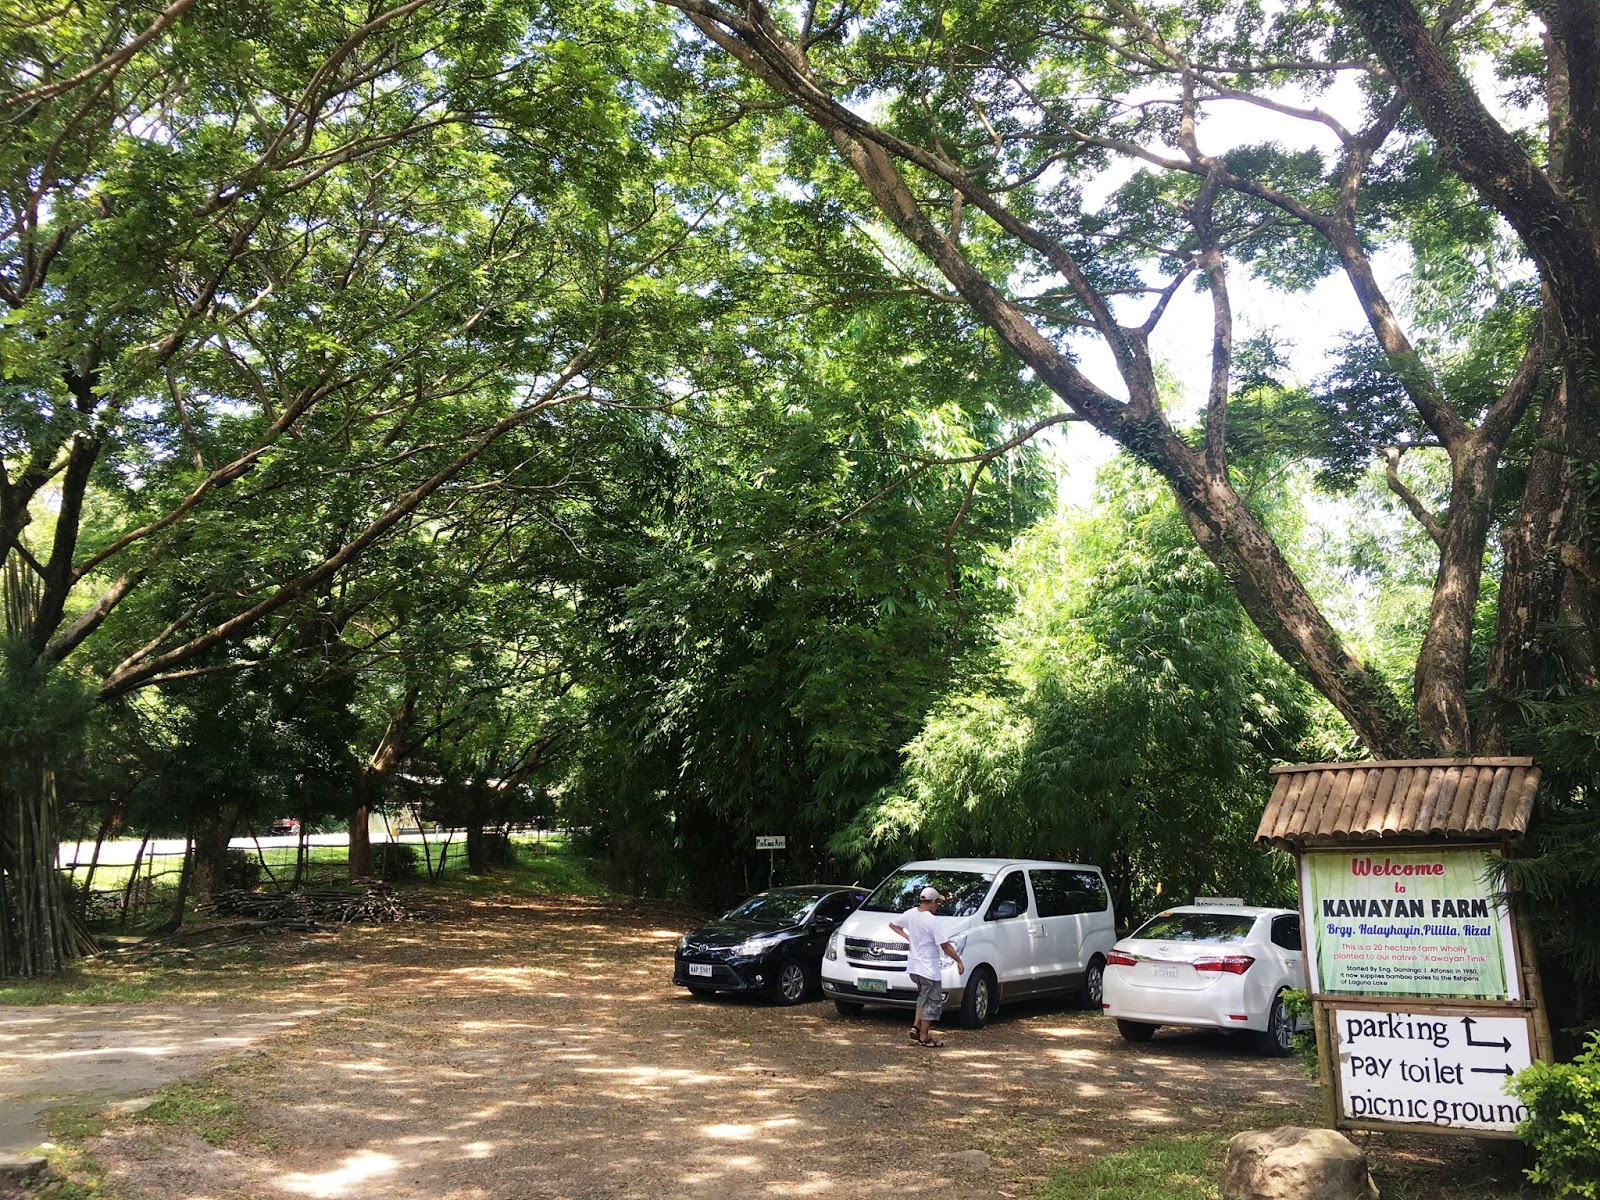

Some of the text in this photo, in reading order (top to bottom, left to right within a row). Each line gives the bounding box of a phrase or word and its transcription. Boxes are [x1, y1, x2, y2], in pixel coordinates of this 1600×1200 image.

[1352, 857, 1444, 877] Welcome
[1394, 881, 1406, 893] to
[1323, 899, 1489, 918] KAWAYAN FARM
[1326, 923, 1355, 938] Brgy.
[1462, 924, 1491, 936] Rizal
[1333, 953, 1364, 961] planted
[1391, 953, 1417, 961] native
[1341, 943, 1356, 951] This
[1384, 944, 1416, 952] hectare
[1440, 945, 1467, 954] Wholly
[1346, 1013, 1449, 1048] parking
[1400, 1057, 1464, 1085] toilet
[1350, 1089, 1429, 1119] picnic
